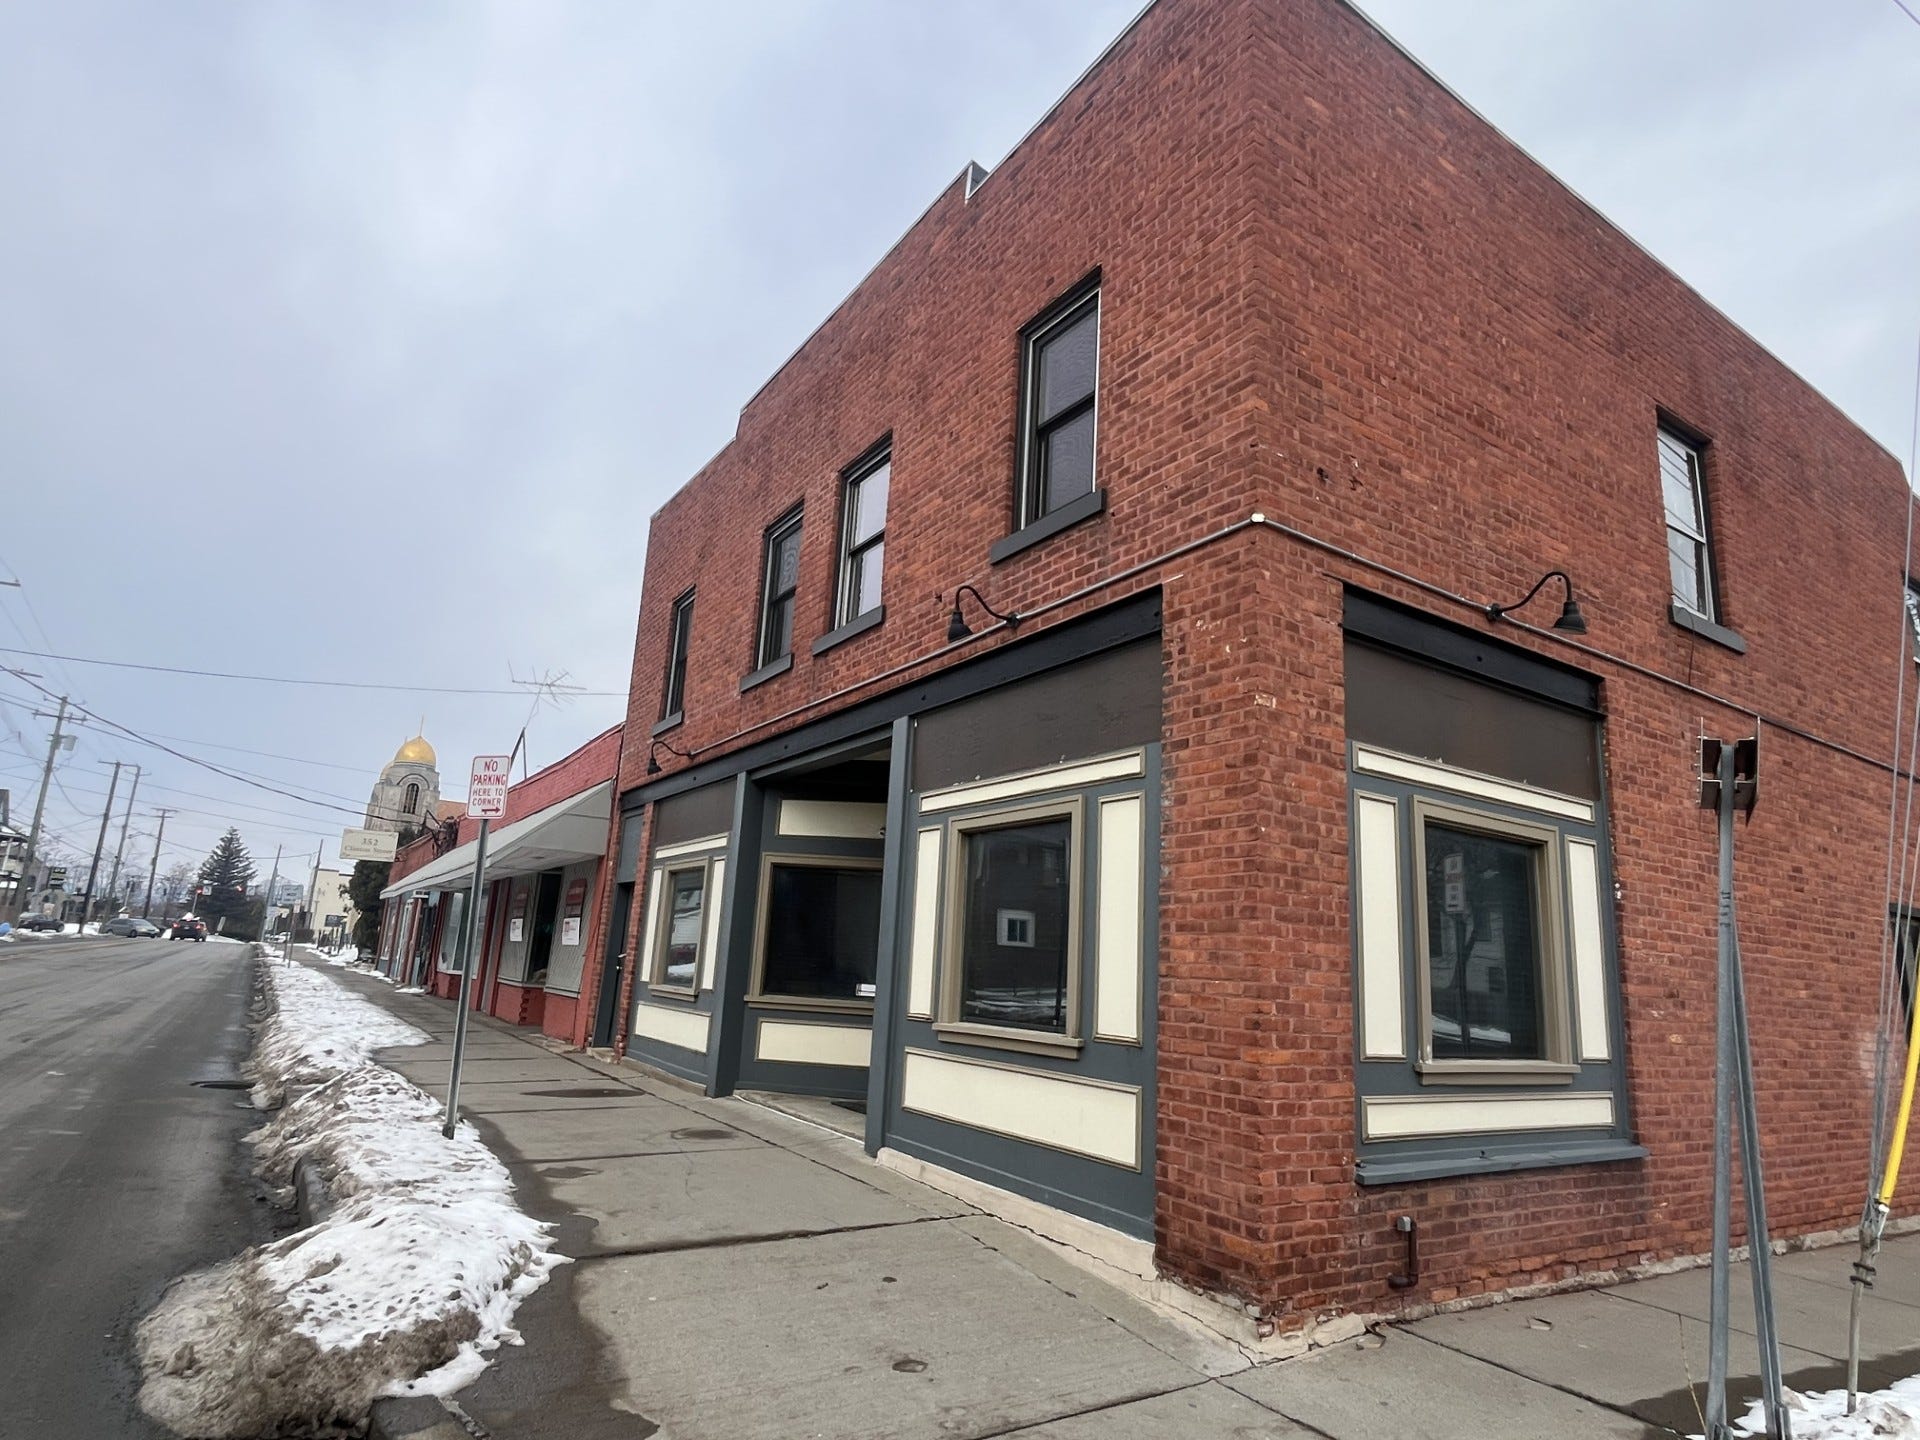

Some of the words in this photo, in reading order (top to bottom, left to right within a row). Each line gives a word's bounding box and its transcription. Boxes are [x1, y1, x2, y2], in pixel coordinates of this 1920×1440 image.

[484, 760, 498, 772] NO
[472, 774, 506, 786] PARKING
[472, 787, 491, 797] HERE
[495, 787, 503, 797] TO
[472, 798, 502, 806] CORNER
